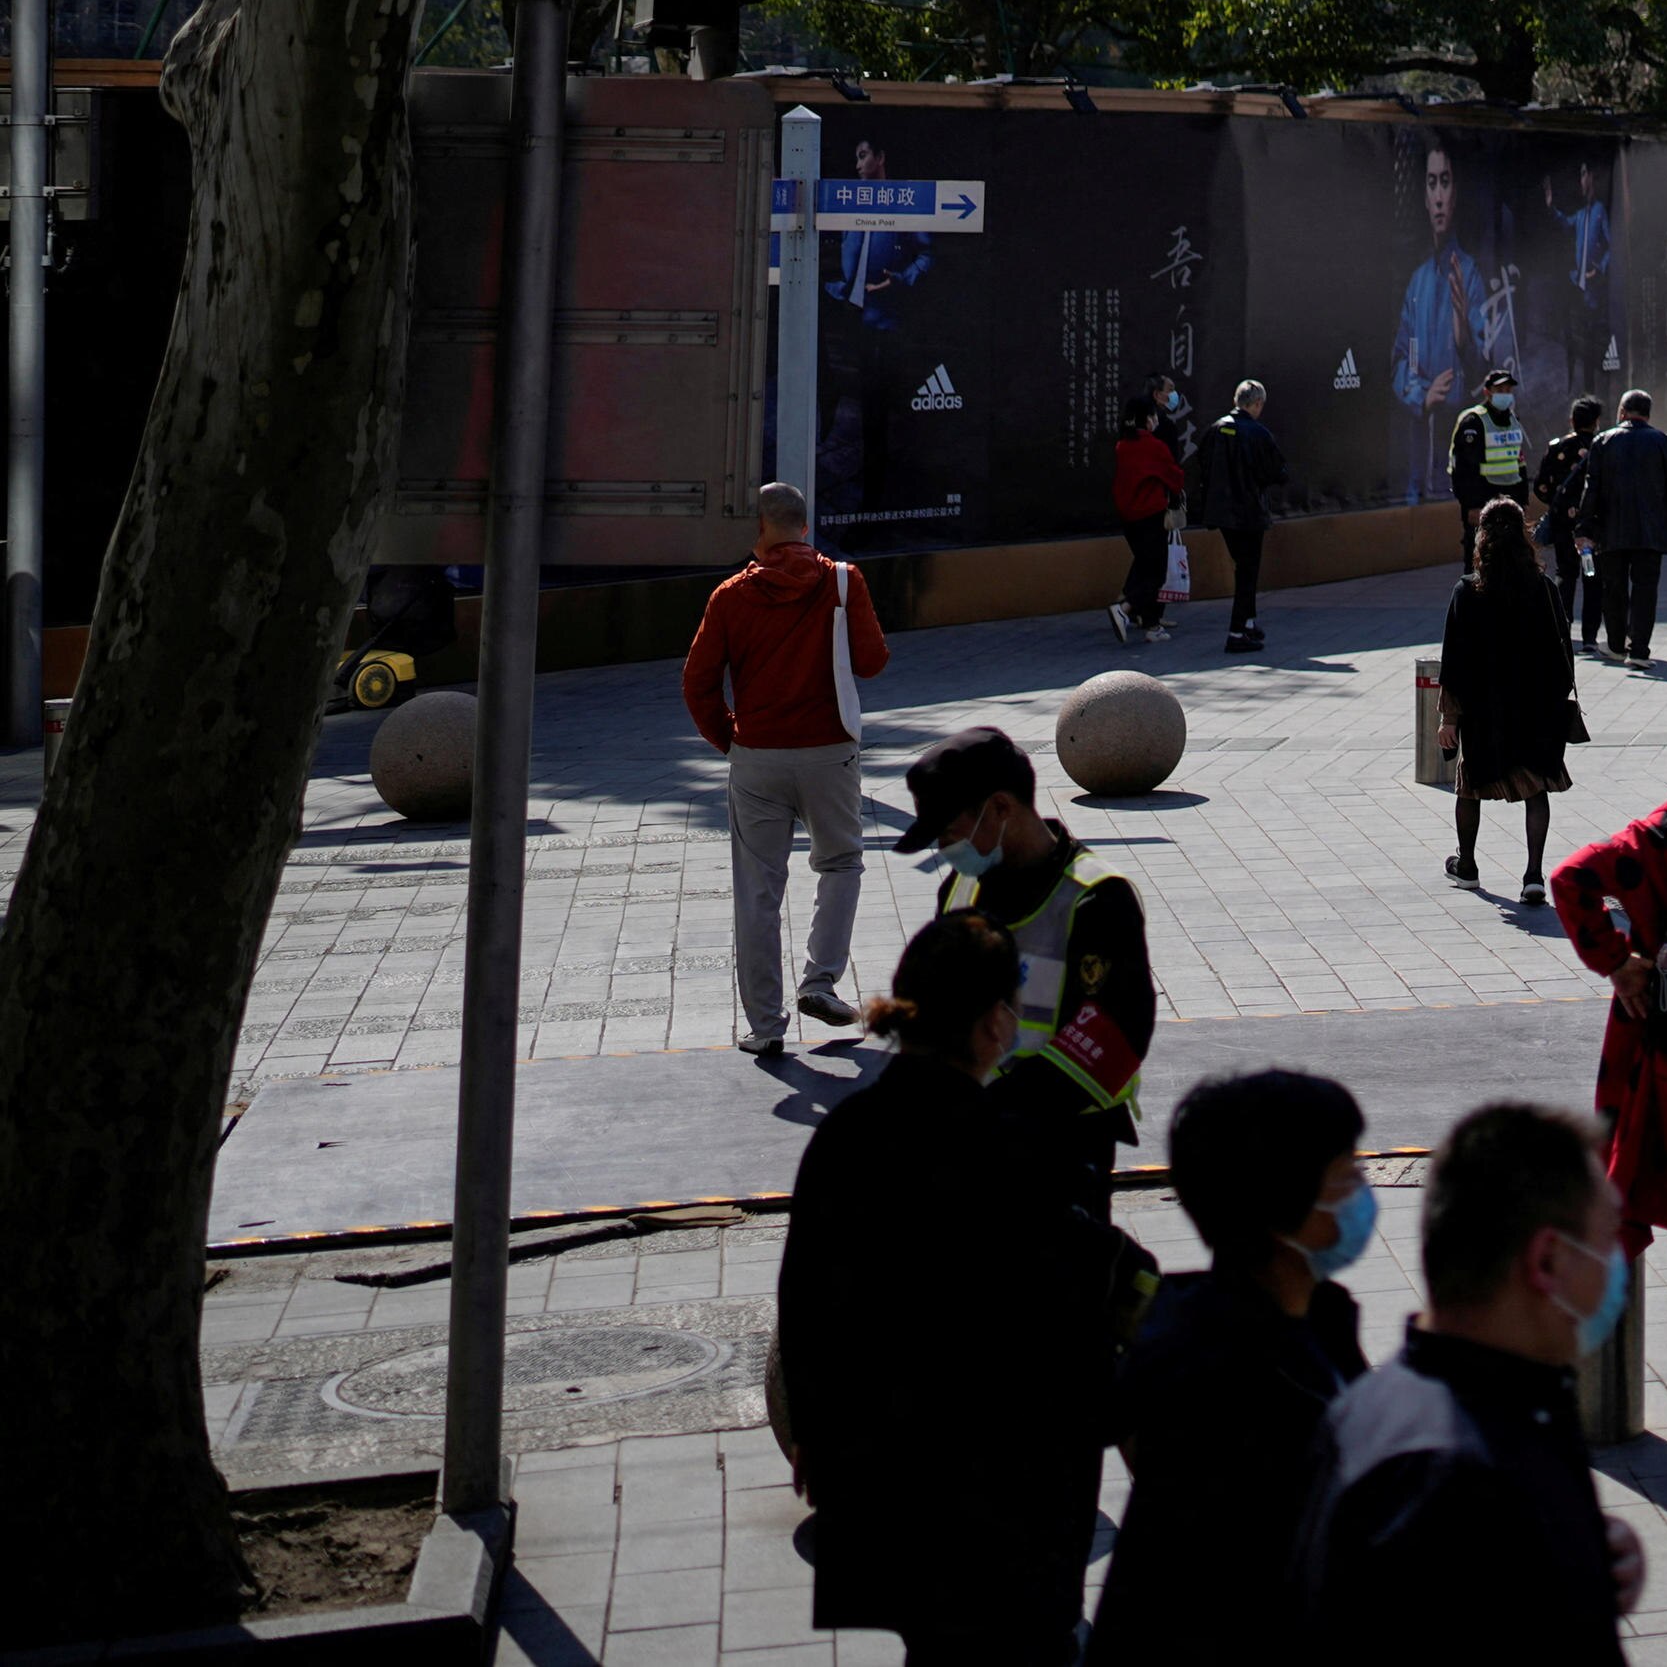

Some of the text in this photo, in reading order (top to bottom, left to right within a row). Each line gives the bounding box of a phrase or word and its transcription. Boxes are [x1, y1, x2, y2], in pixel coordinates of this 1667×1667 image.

[836, 185, 916, 207] 中国邮政
[855, 218, 896, 227] China Post
[1333, 373, 1361, 391] adidas
[910, 394, 964, 411] adidas
